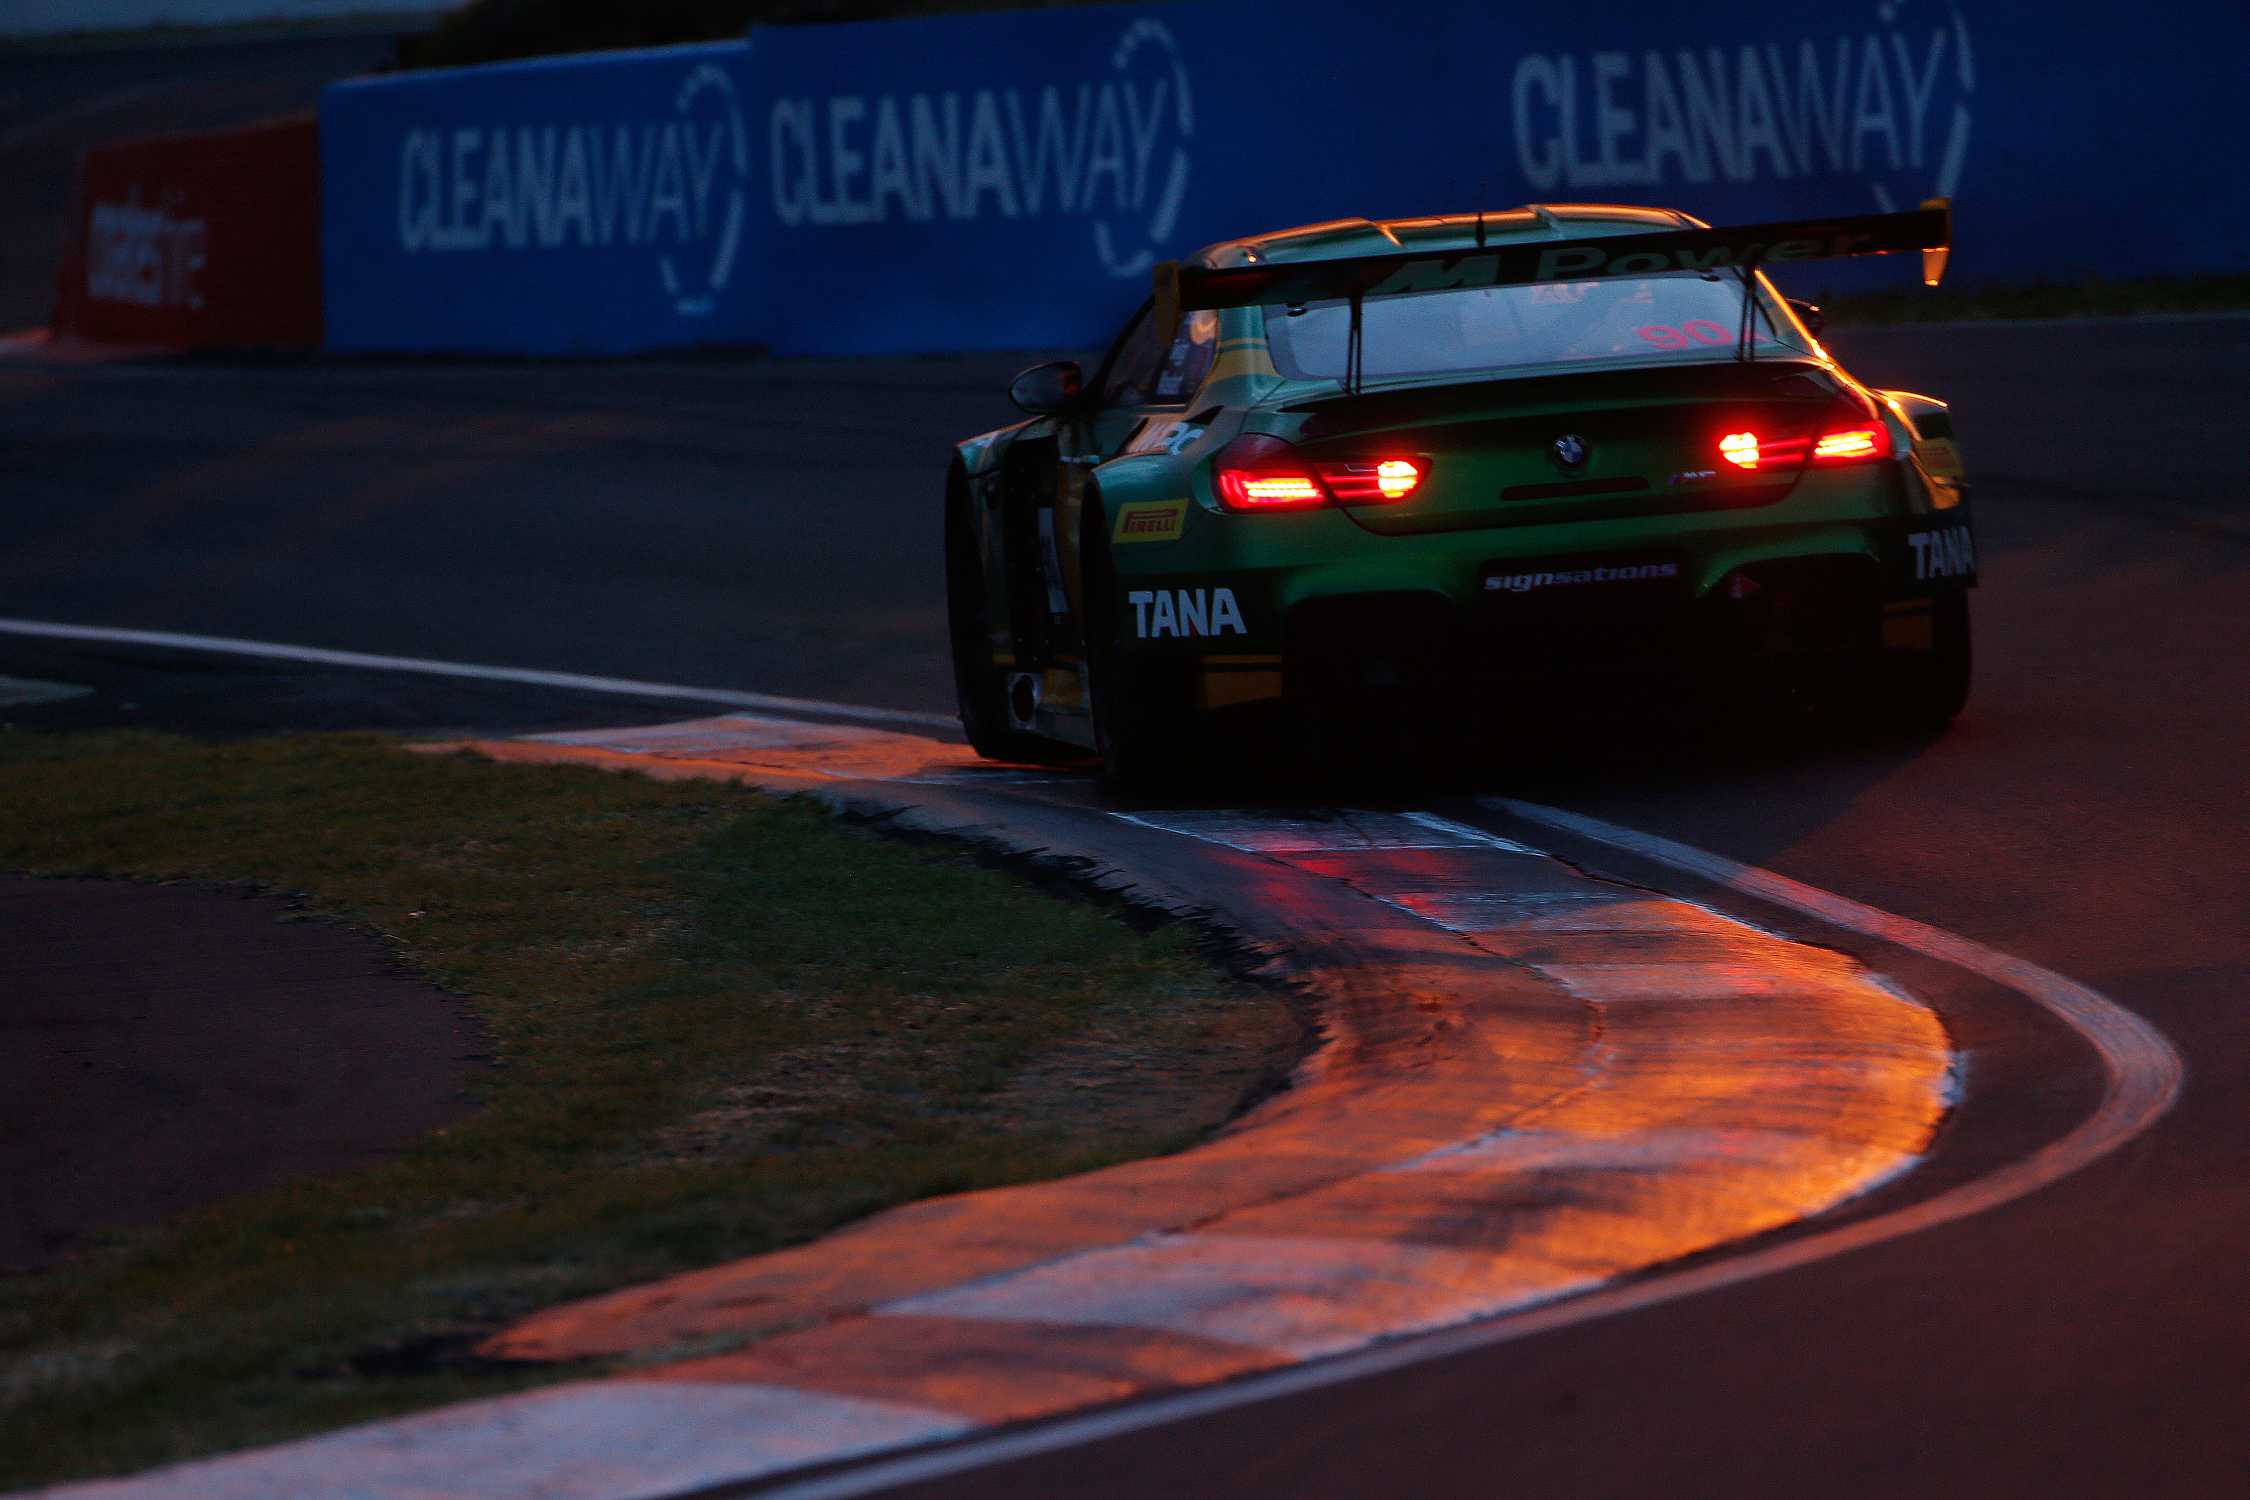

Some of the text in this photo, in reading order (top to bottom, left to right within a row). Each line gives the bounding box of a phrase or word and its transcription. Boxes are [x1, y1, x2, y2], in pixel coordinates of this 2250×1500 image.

[1512, 27, 1946, 189] CLEANAWAY
[770, 84, 1168, 226] CLEANAWAY
[398, 121, 725, 252] CLEANAWAY
[1536, 233, 1872, 283] Power
[1636, 320, 1733, 350] 90
[1484, 562, 1679, 592] signsations
[1908, 526, 1975, 580] TANA
[1128, 587, 1248, 639] TANA
